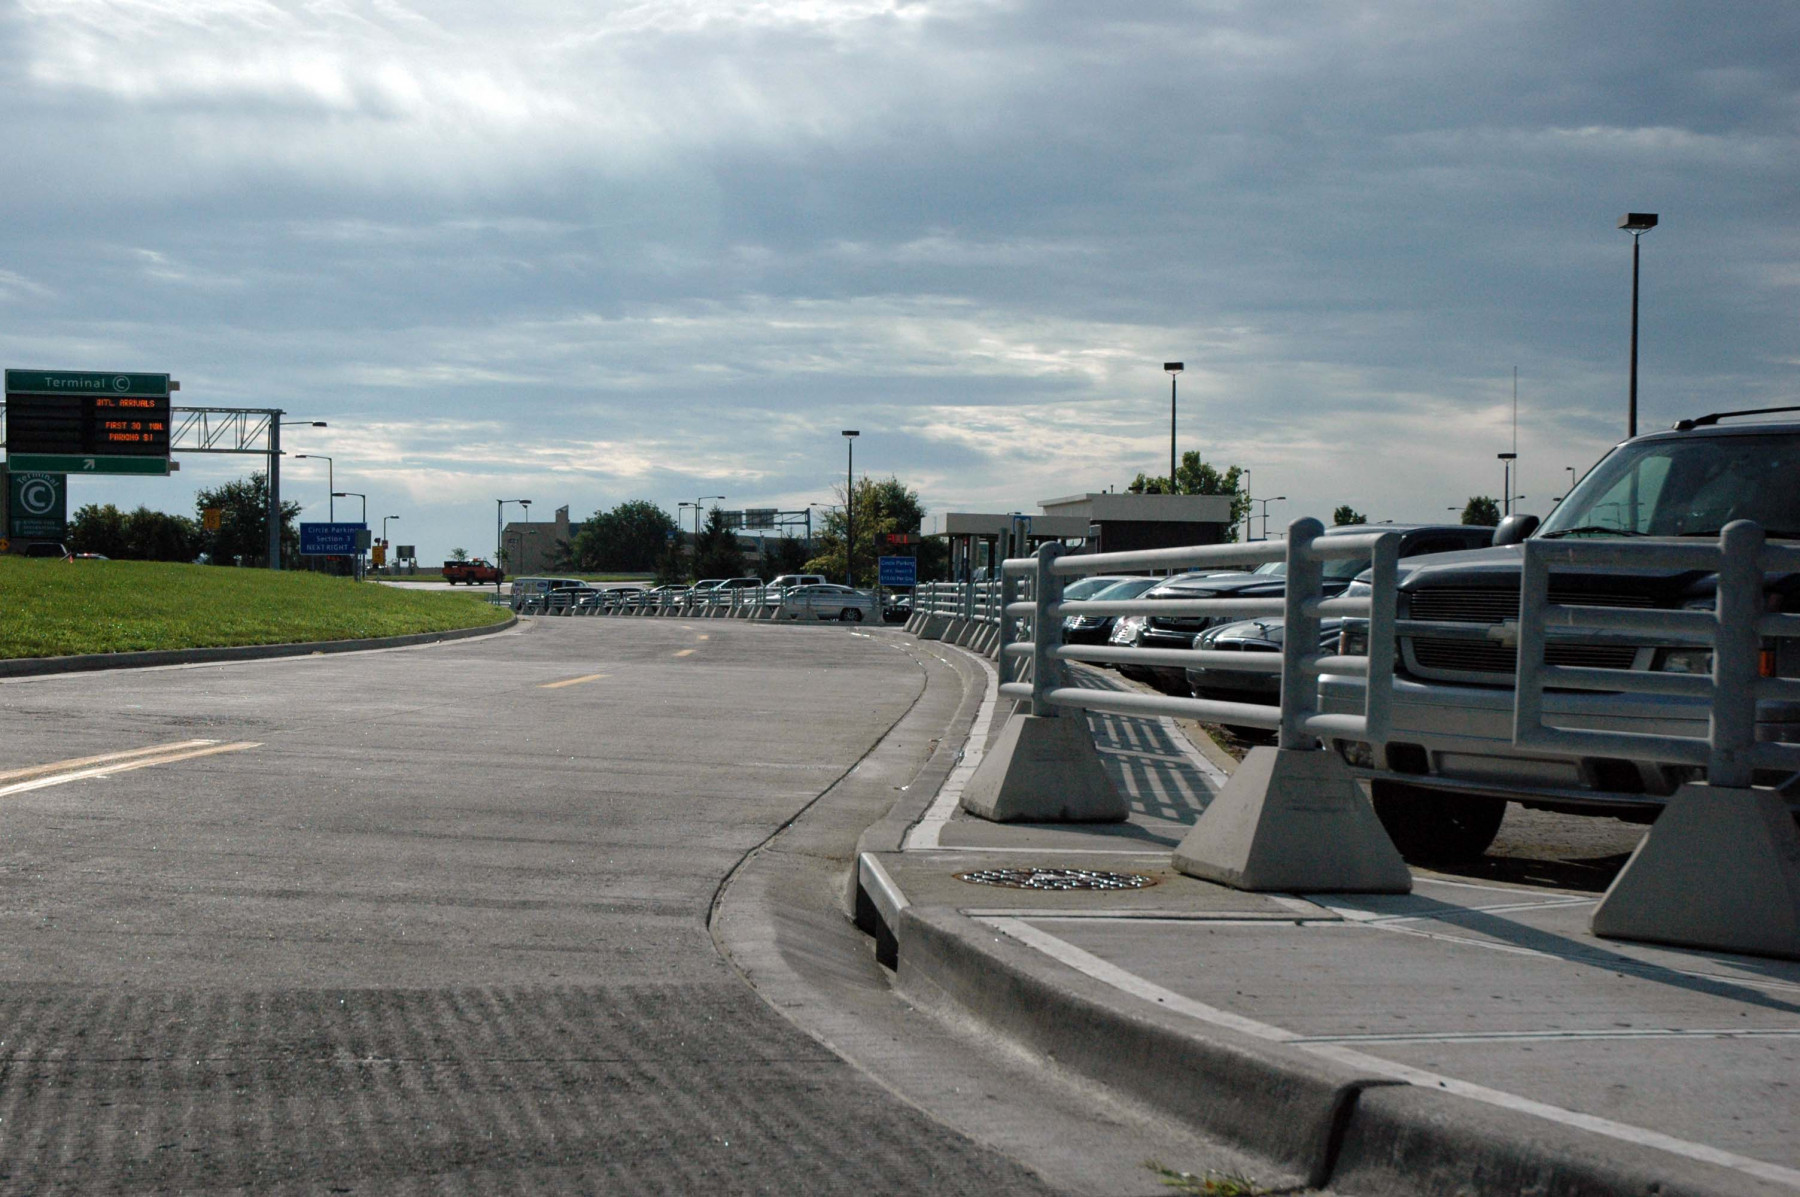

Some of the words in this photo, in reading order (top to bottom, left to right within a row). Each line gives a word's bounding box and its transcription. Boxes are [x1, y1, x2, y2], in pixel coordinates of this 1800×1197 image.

[44, 377, 105, 389] Terminal
[119, 399, 155, 407] ARRIVALS
[105, 421, 127, 430] FIRST
[131, 422, 141, 430] 30
[109, 433, 139, 441] PARKING
[143, 433, 153, 442] $1
[16, 472, 60, 487] Terminal
[28, 486, 46, 507] C
[307, 526, 329, 534] Circle
[331, 526, 359, 534] Parkin
